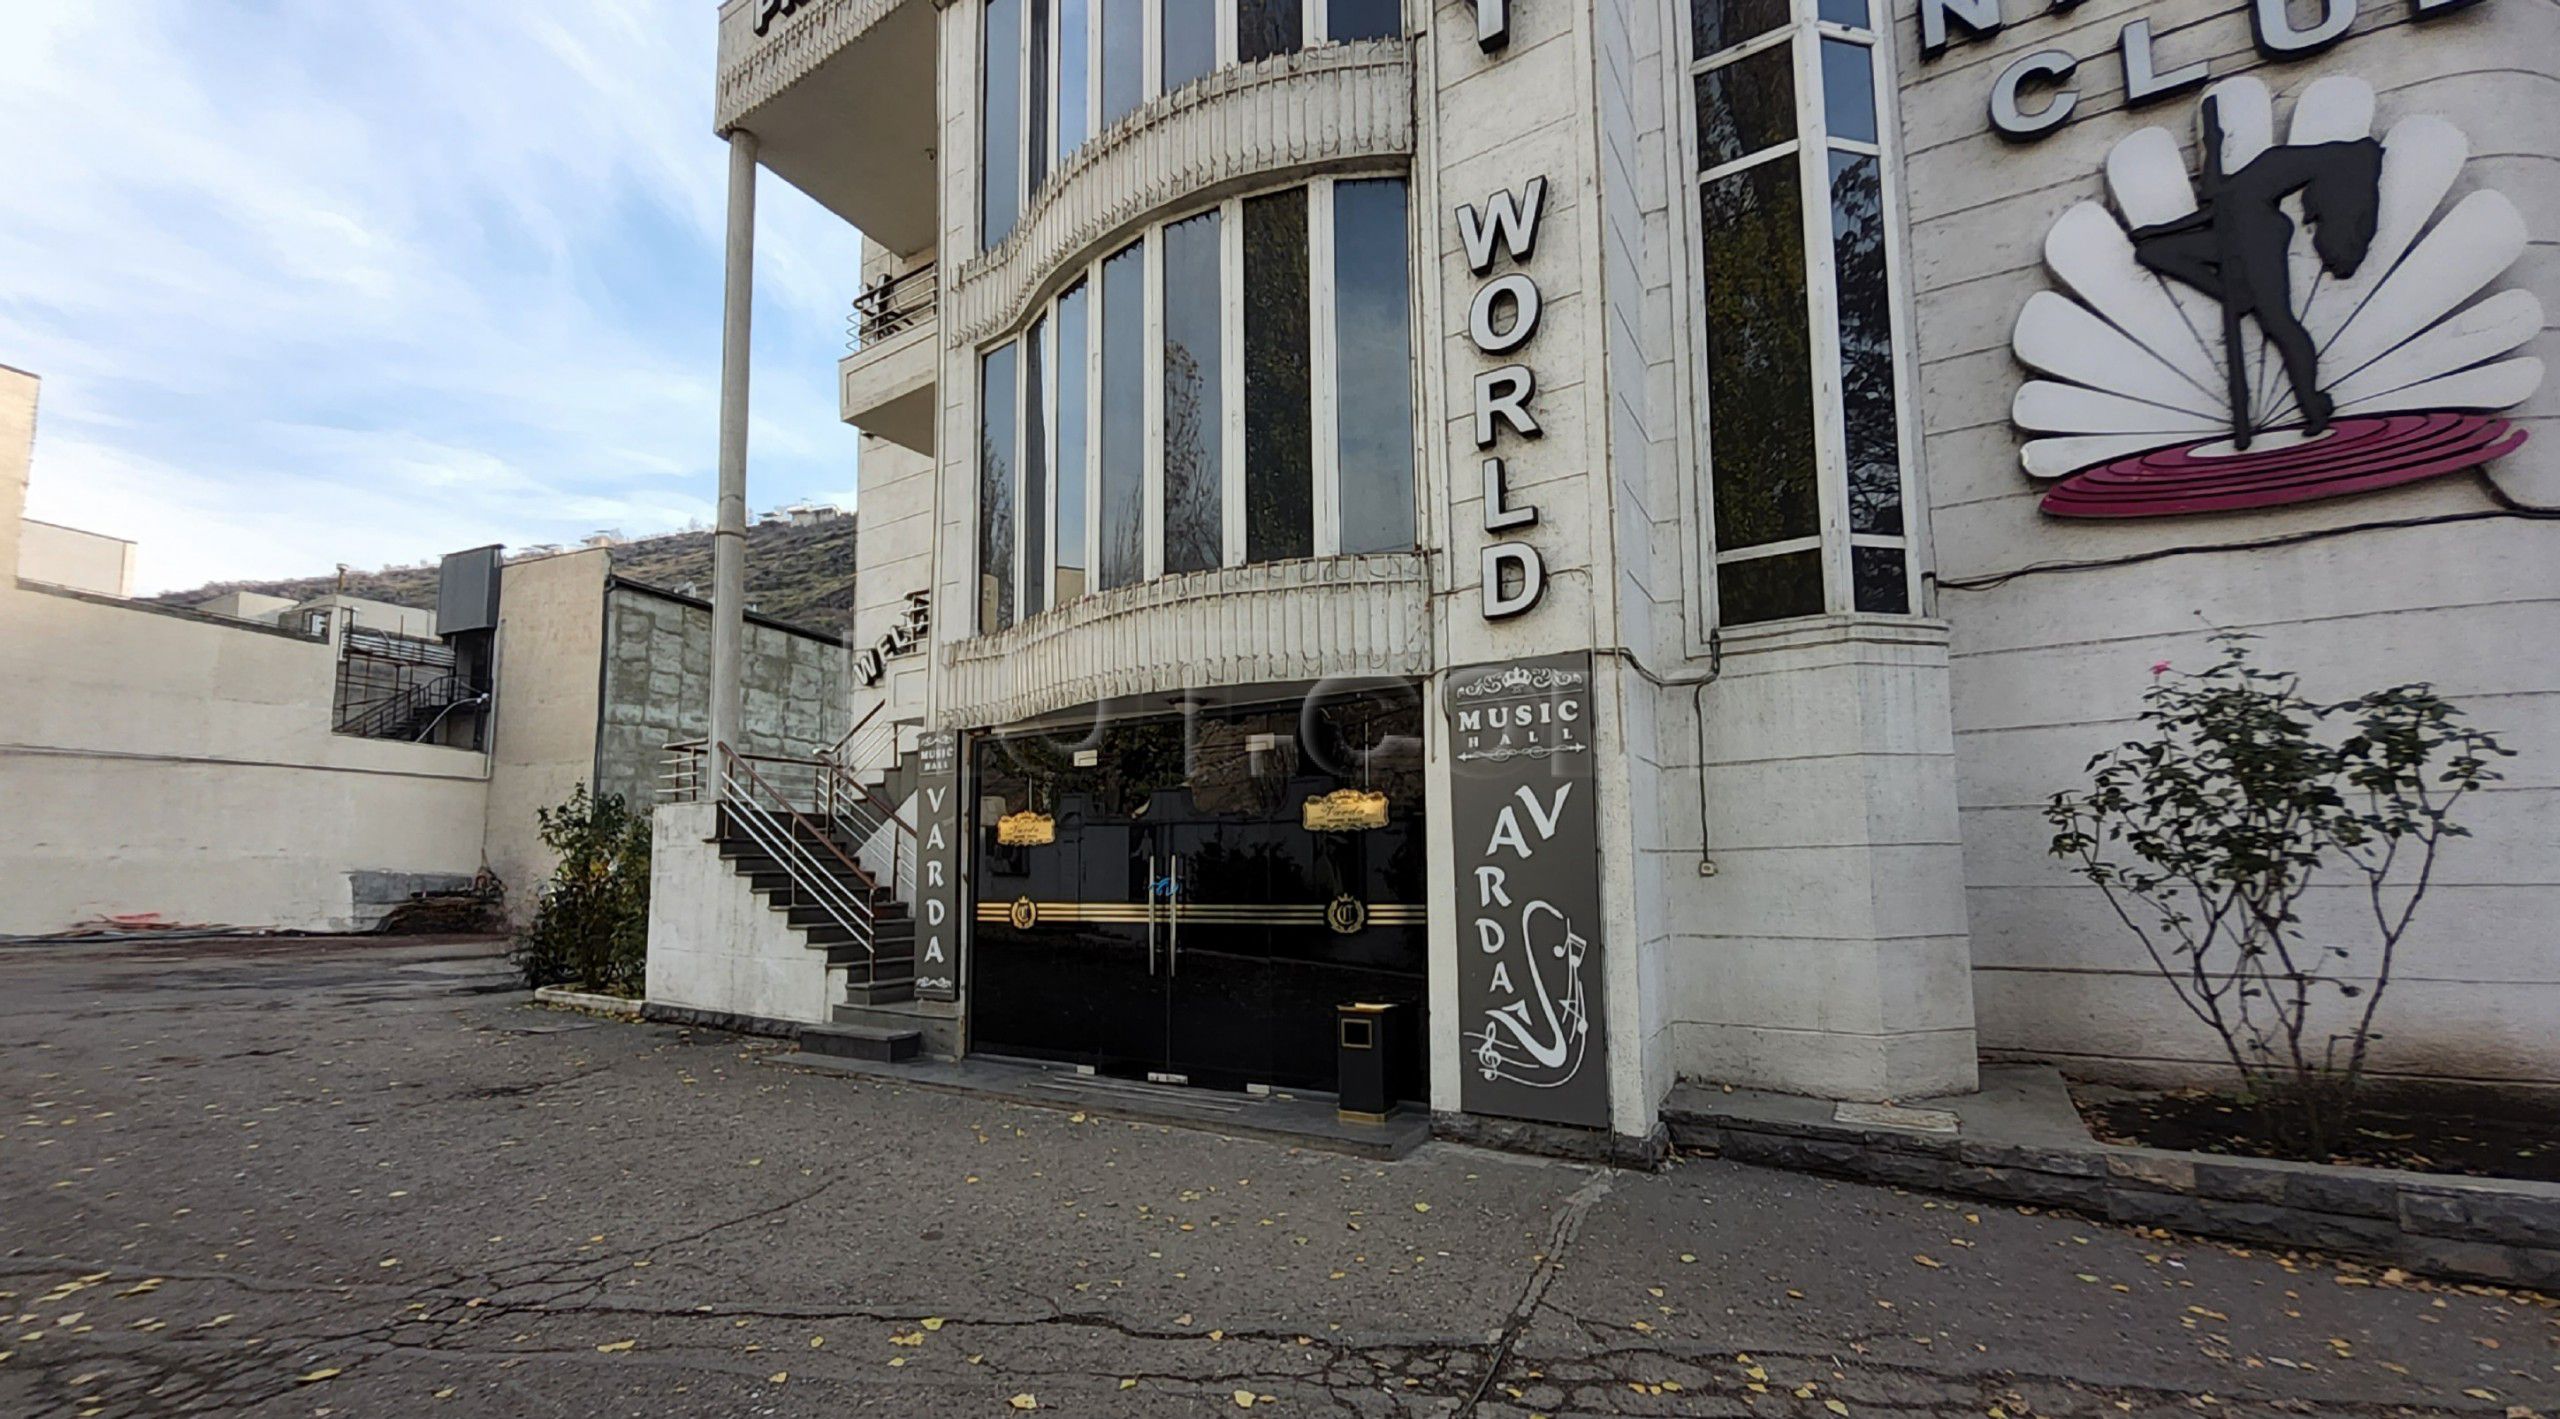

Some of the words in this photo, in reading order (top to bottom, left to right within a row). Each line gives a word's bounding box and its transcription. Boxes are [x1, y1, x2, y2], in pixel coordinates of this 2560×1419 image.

[1989, 0, 2484, 140] CLU
[1454, 174, 1548, 622] WORLD
[920, 746, 954, 760] MUSIC
[1458, 699, 1579, 733] MUSIC
[1467, 727, 1573, 749] HALL
[924, 760, 949, 771] HALL
[923, 784, 947, 965] VARDA
[1472, 780, 1573, 996] VARDA
